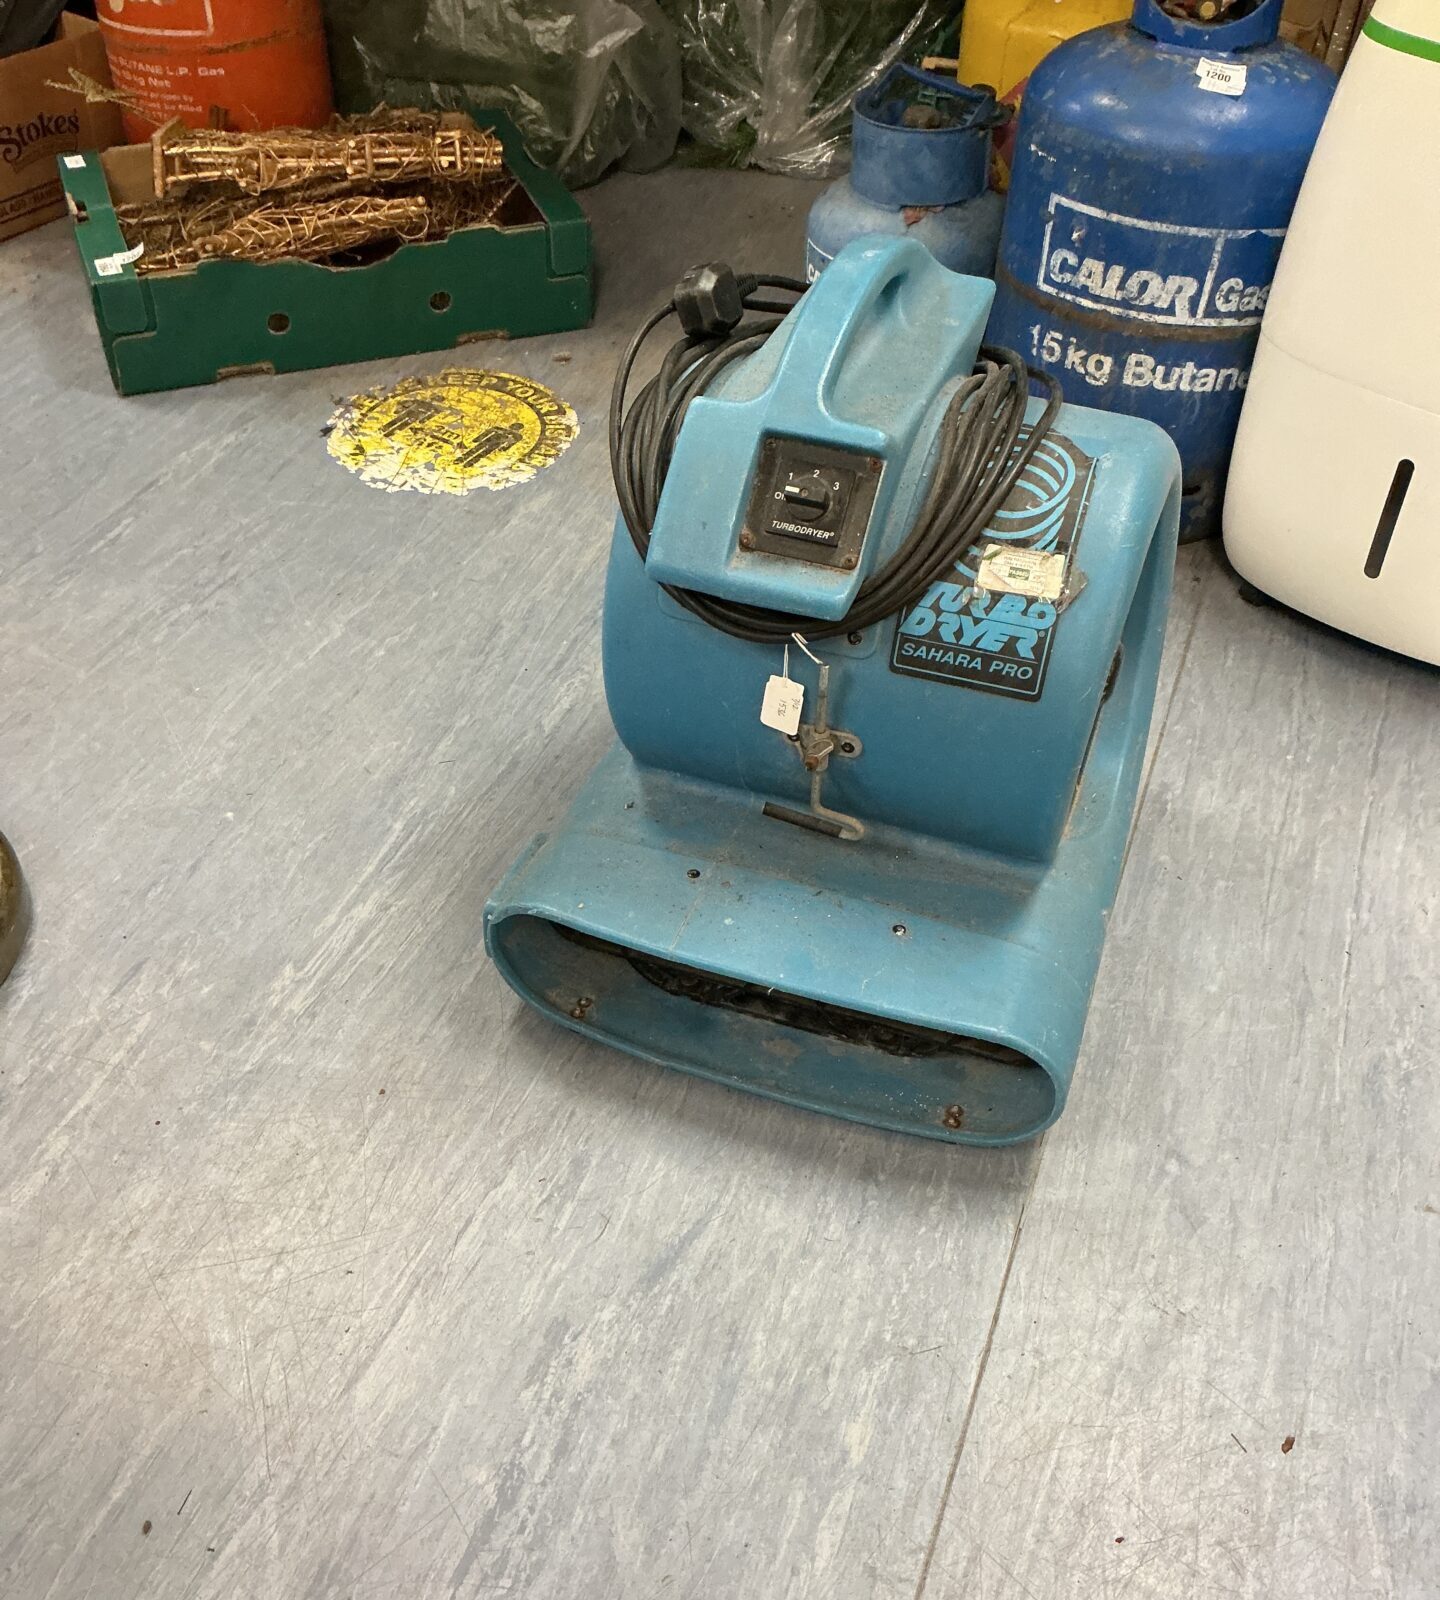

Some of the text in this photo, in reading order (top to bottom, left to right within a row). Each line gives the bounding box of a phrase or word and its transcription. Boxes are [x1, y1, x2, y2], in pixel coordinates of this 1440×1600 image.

[198, 66, 225, 77] Gas
[1206, 70, 1232, 83] 1200
[148, 76, 172, 88] Net
[1049, 248, 1199, 318] CALOR
[427, 372, 499, 387] KEEP
[506, 380, 560, 415] YOUR
[788, 472, 794, 480] 1
[813, 469, 820, 478] 2
[832, 481, 840, 490] 3
[918, 580, 1057, 630] TURBO
[901, 642, 1033, 680] SAHARA PRO
